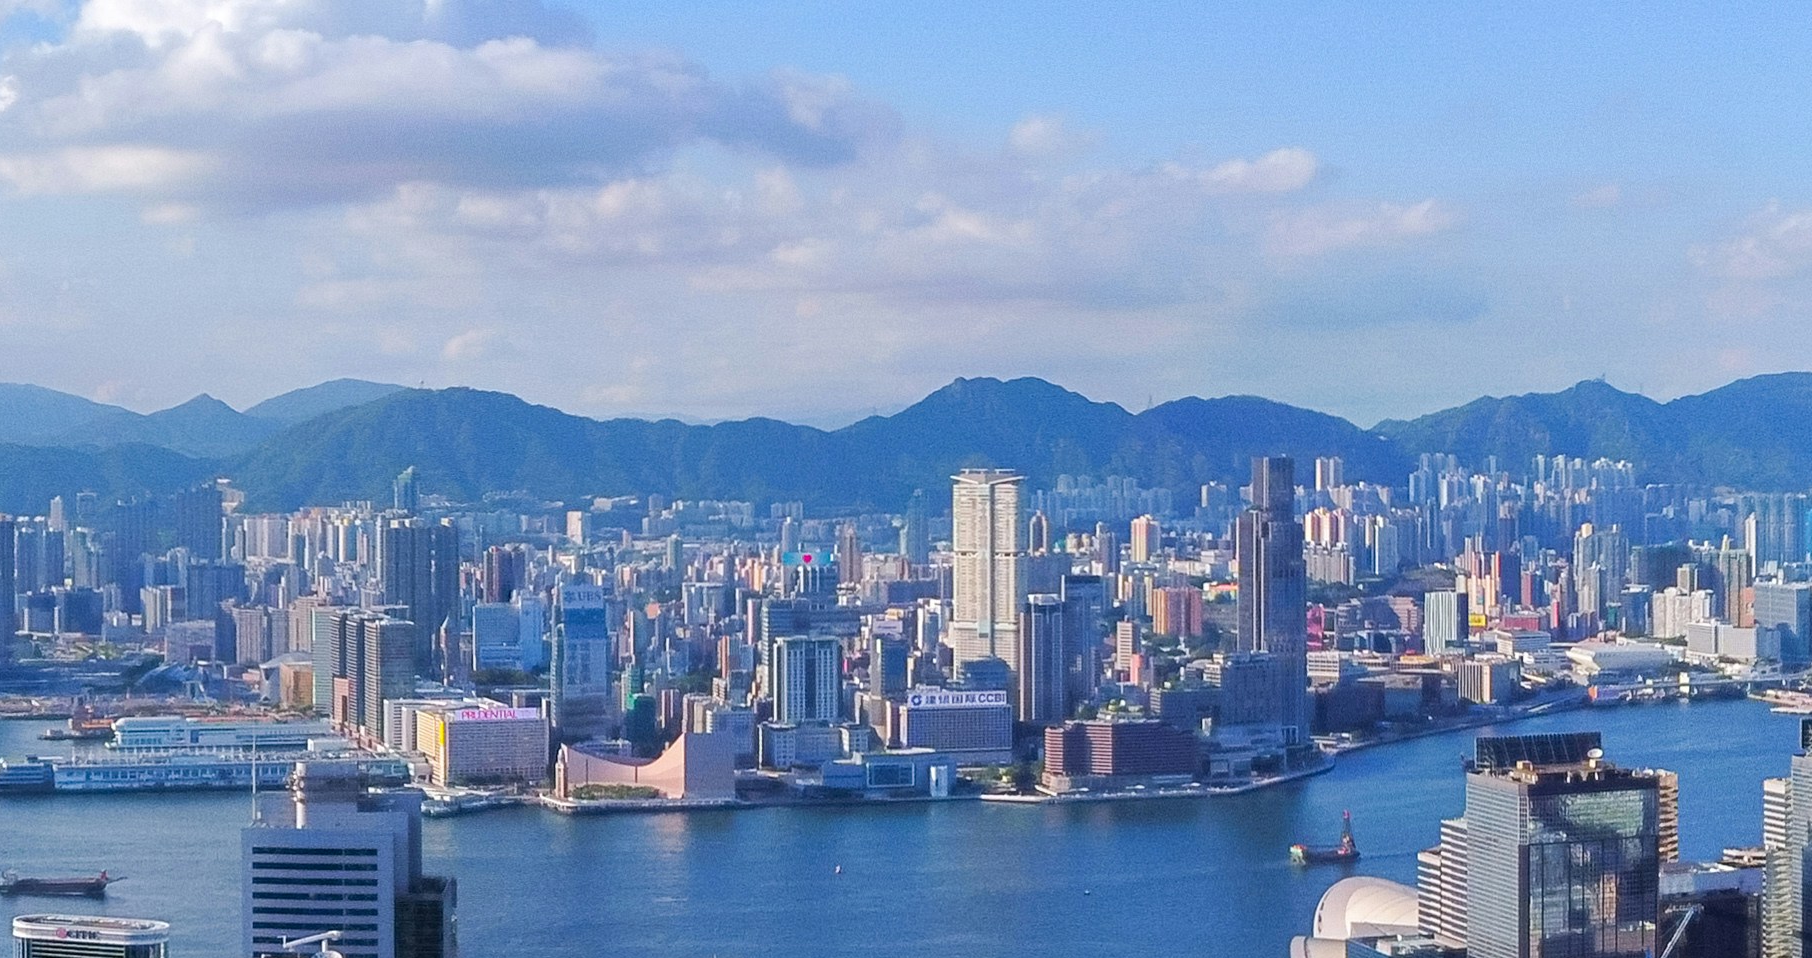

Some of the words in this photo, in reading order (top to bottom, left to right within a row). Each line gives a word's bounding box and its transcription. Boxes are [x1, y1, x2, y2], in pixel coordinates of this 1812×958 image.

[578, 591, 601, 601] UBS
[978, 693, 1006, 703] CCBI
[461, 709, 517, 720] PRUDENTIAL
